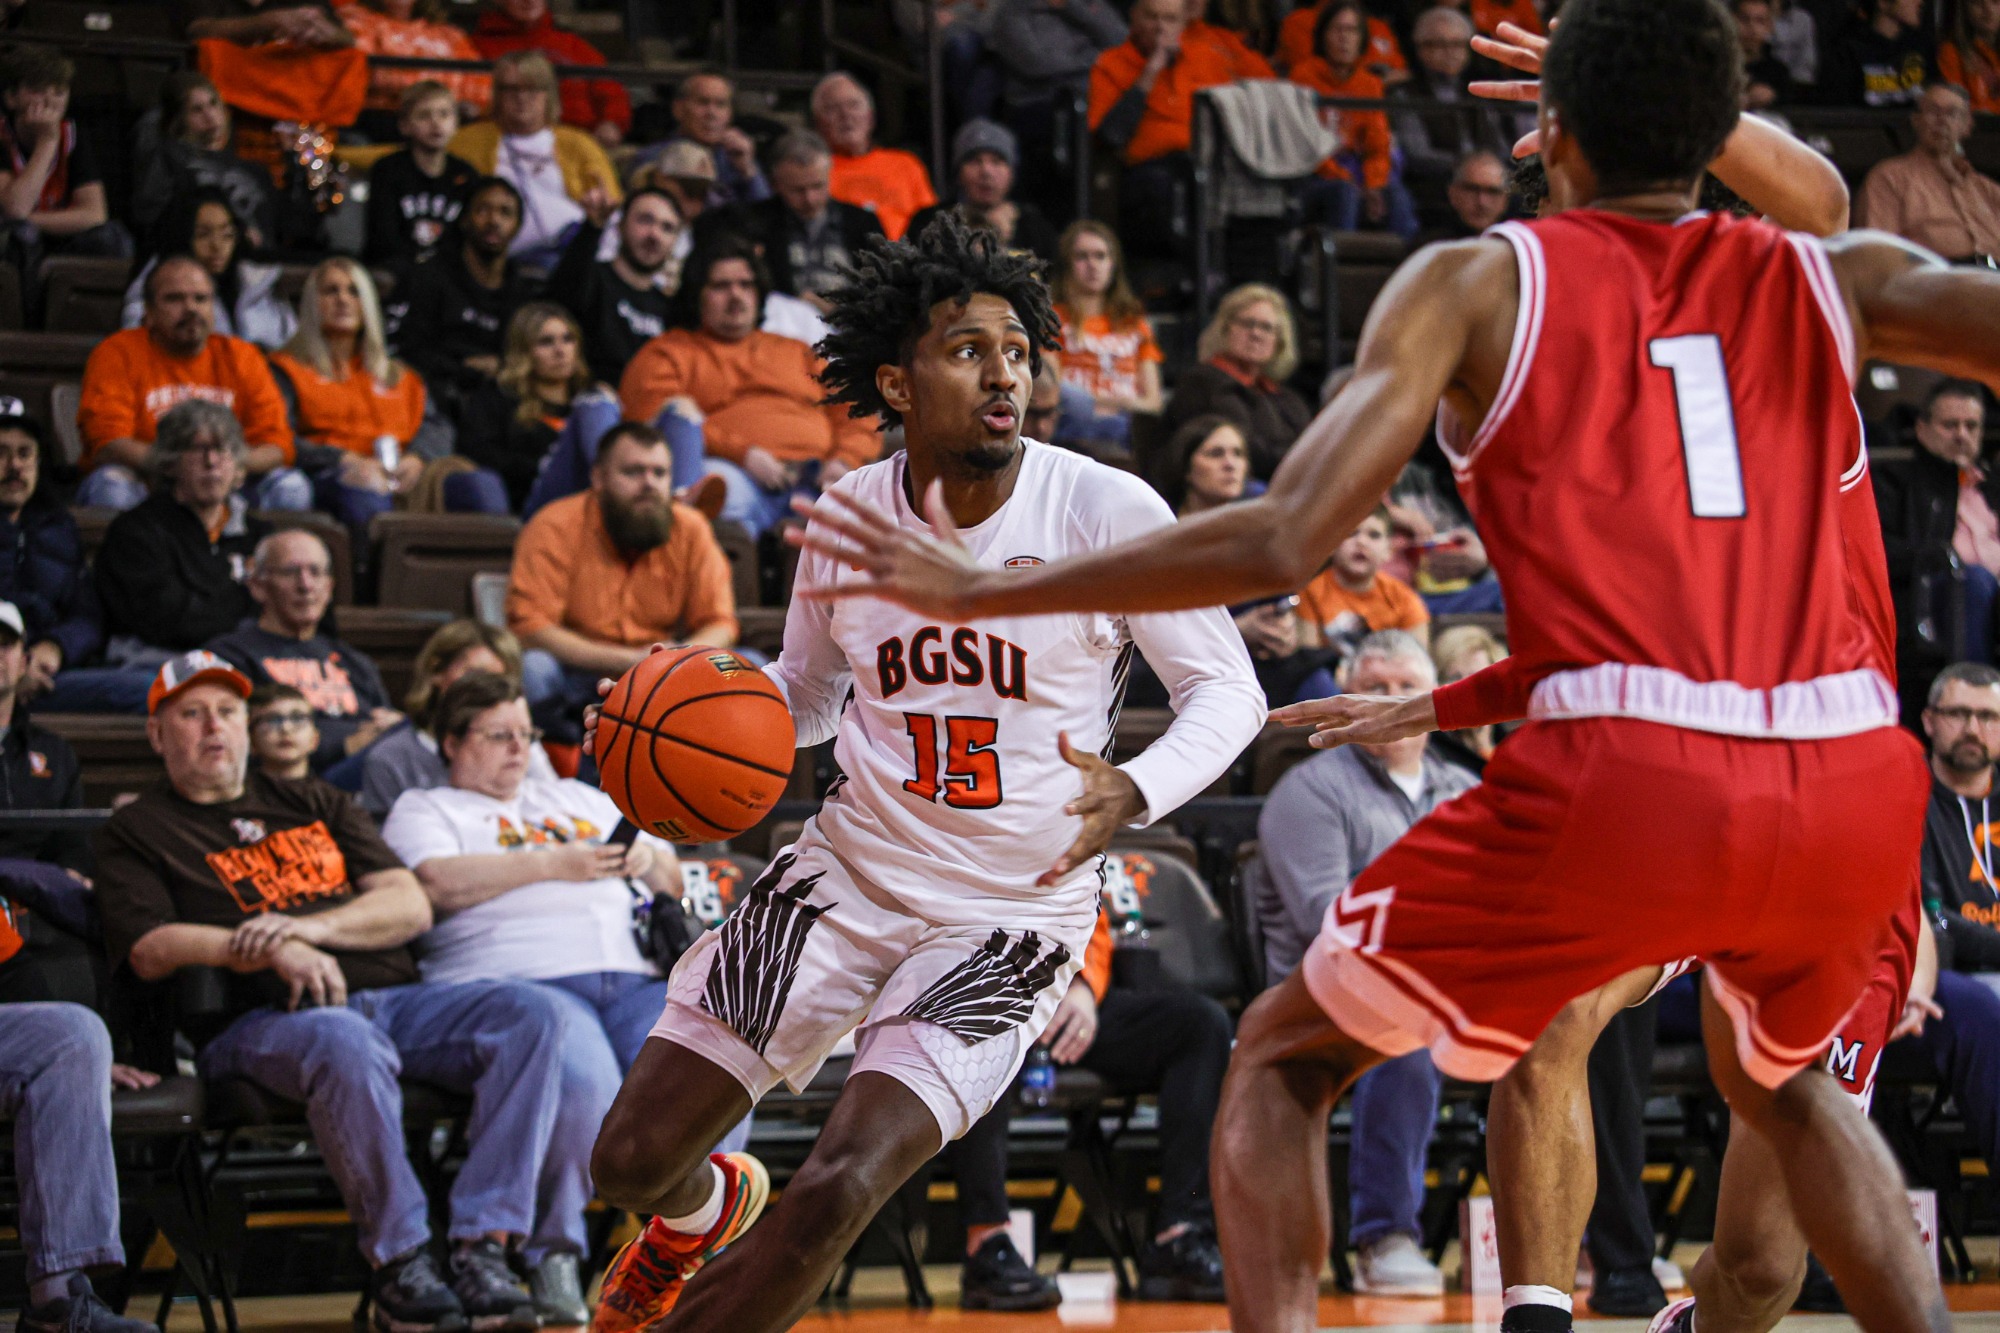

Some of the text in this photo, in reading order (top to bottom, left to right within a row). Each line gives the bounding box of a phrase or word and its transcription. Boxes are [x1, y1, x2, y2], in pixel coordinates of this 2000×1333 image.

[1648, 333, 1747, 519] 1
[877, 625, 1028, 702] BGSU
[902, 711, 1003, 809] 15
[1826, 1034, 1866, 1083] M
